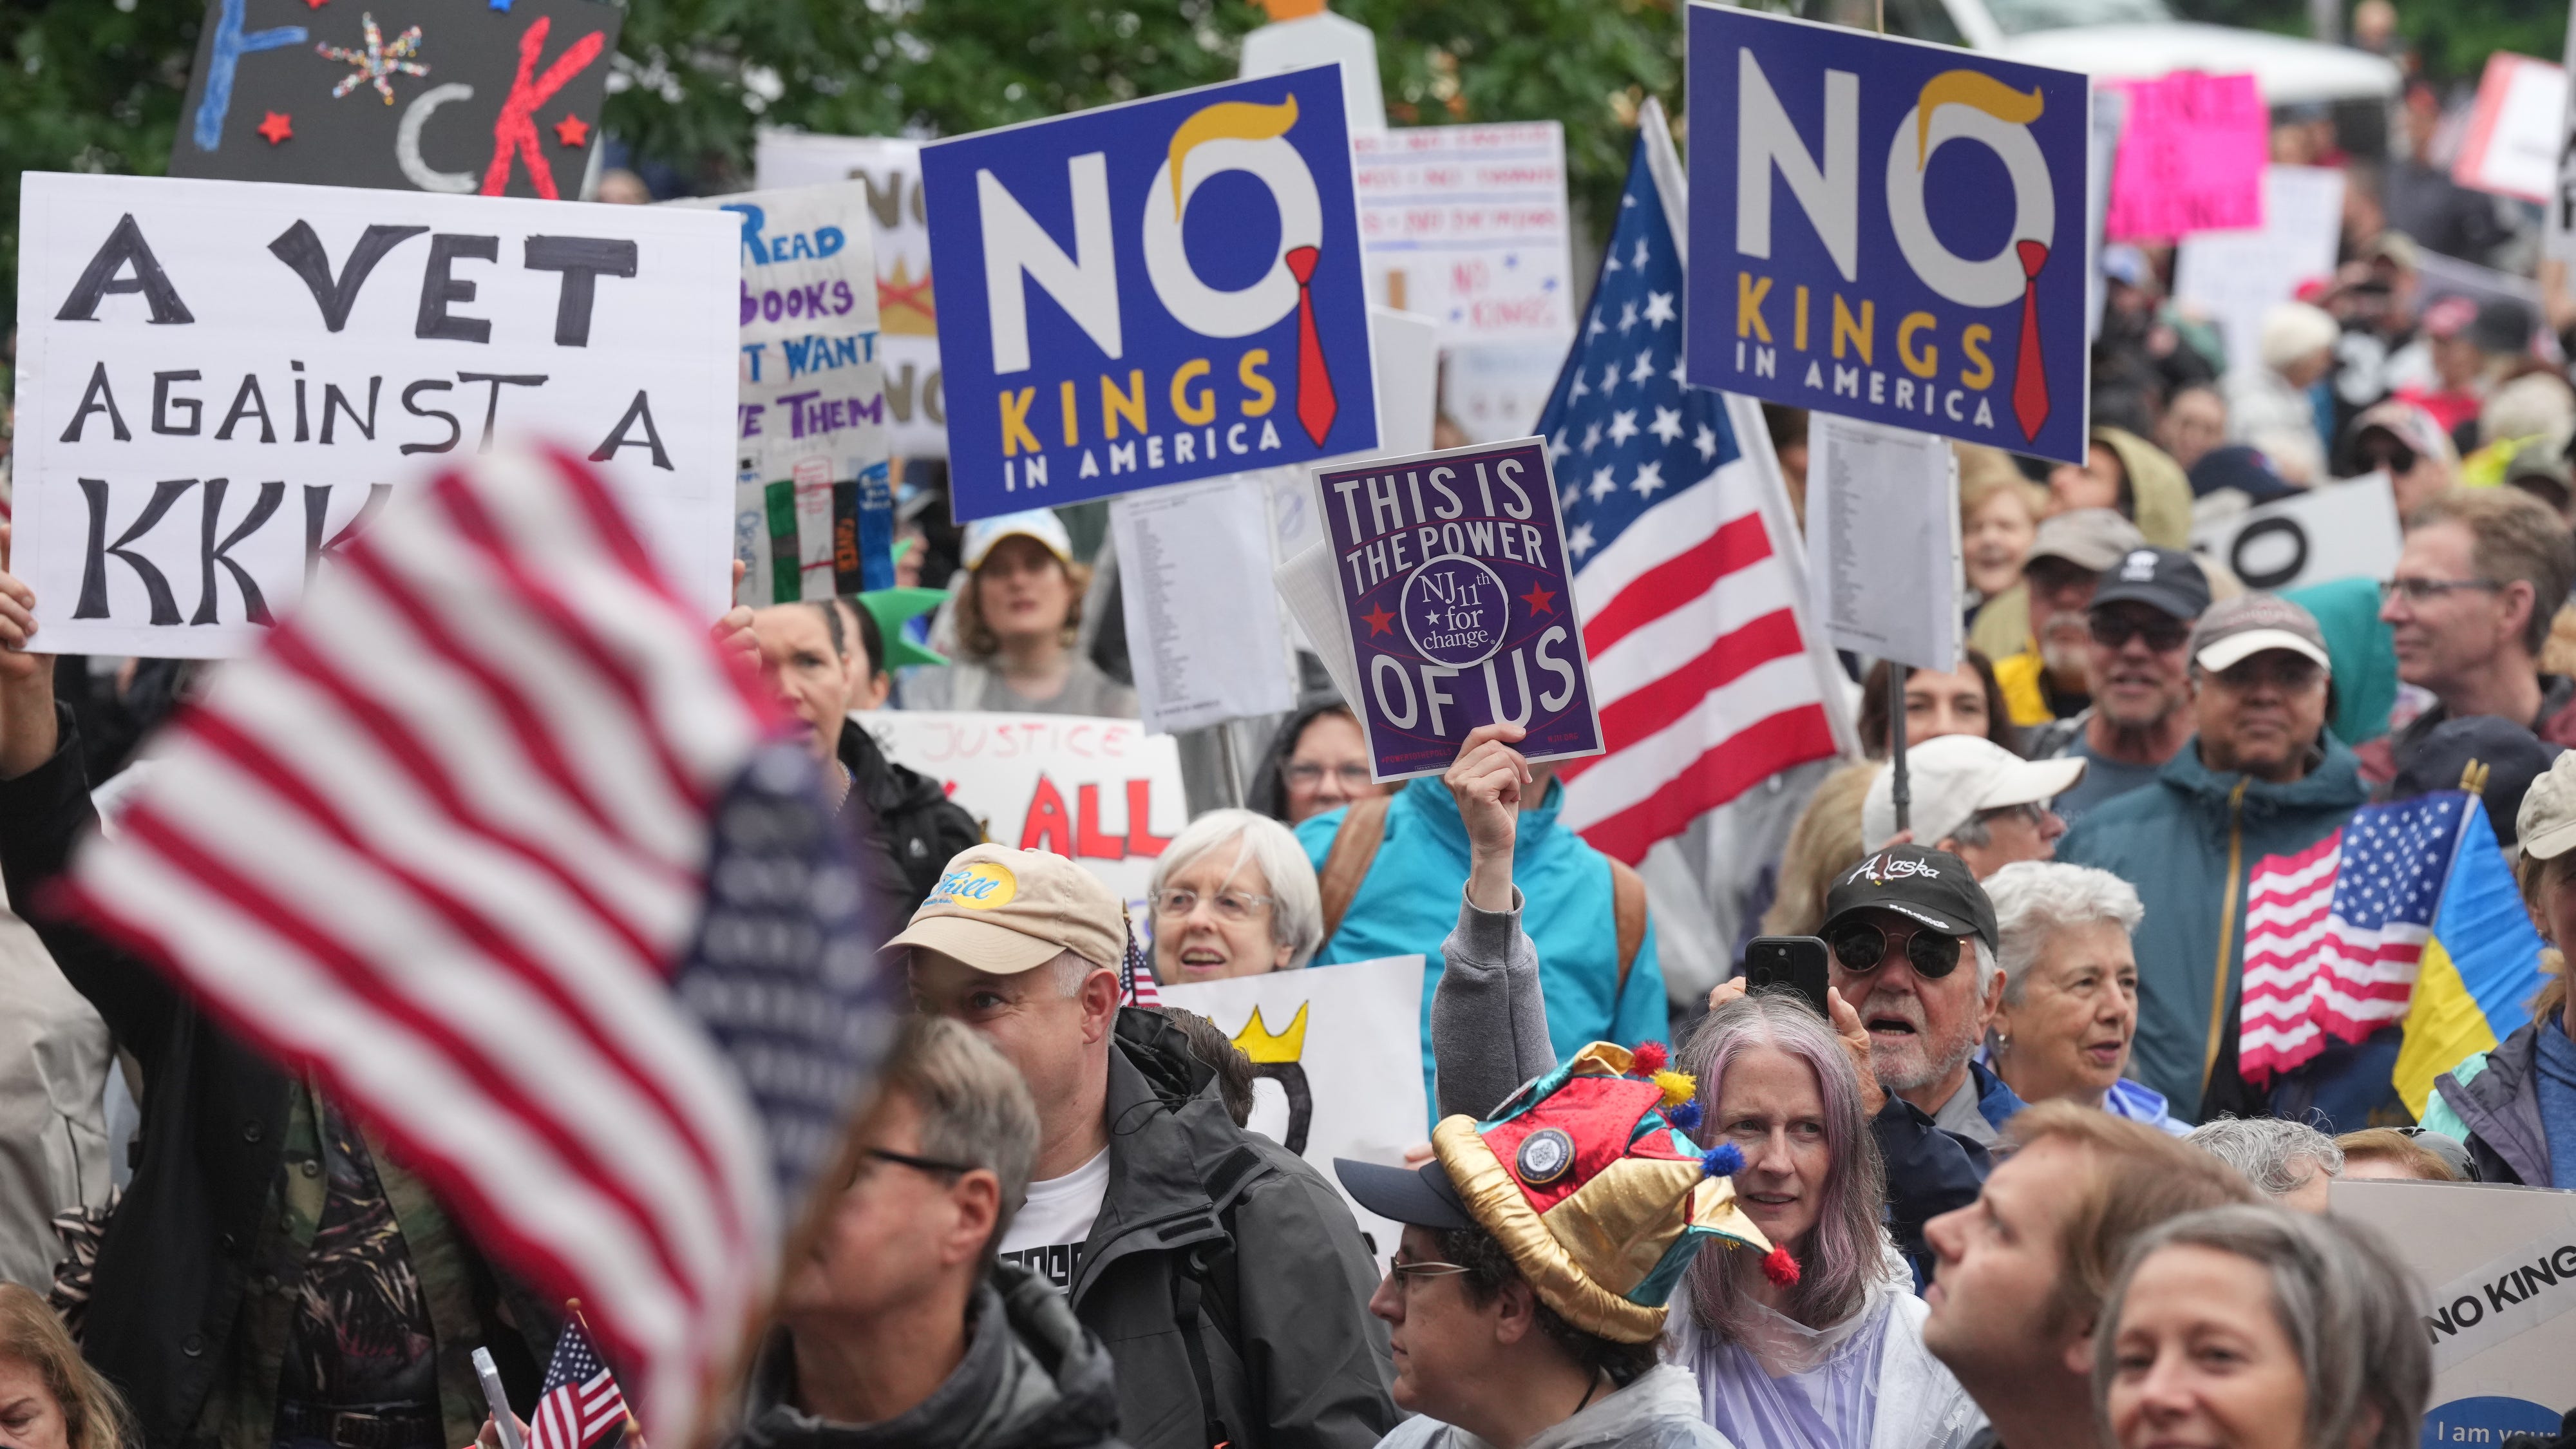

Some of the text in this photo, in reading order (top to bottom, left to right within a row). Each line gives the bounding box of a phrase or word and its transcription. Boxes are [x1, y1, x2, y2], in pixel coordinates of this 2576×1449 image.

[1736, 46, 2056, 308] NO
[55, 213, 638, 348] A VET
[976, 132, 1323, 375] NO
[782, 331, 880, 380] WANT
[1737, 271, 1995, 391] KINGS
[776, 388, 883, 439] THEM
[999, 348, 1276, 457] KINGS
[1736, 341, 1995, 430] IN AMERICA
[588, 389, 674, 471] A
[1004, 419, 1282, 492] IN AMERICA
[1333, 459, 1533, 545] THIS IS
[1346, 521, 1548, 596] THE POWER
[1444, 605, 1484, 631] for
[1370, 625, 1576, 737] OF US
[922, 722, 1131, 763] JUSTICE
[1019, 772, 1175, 860] ALL
[1847, 853, 1940, 885] Alaska
[2421, 1294, 2484, 1345] NO
[2438, 1421, 2444, 1441] I
[2452, 1426, 2490, 1443] am
